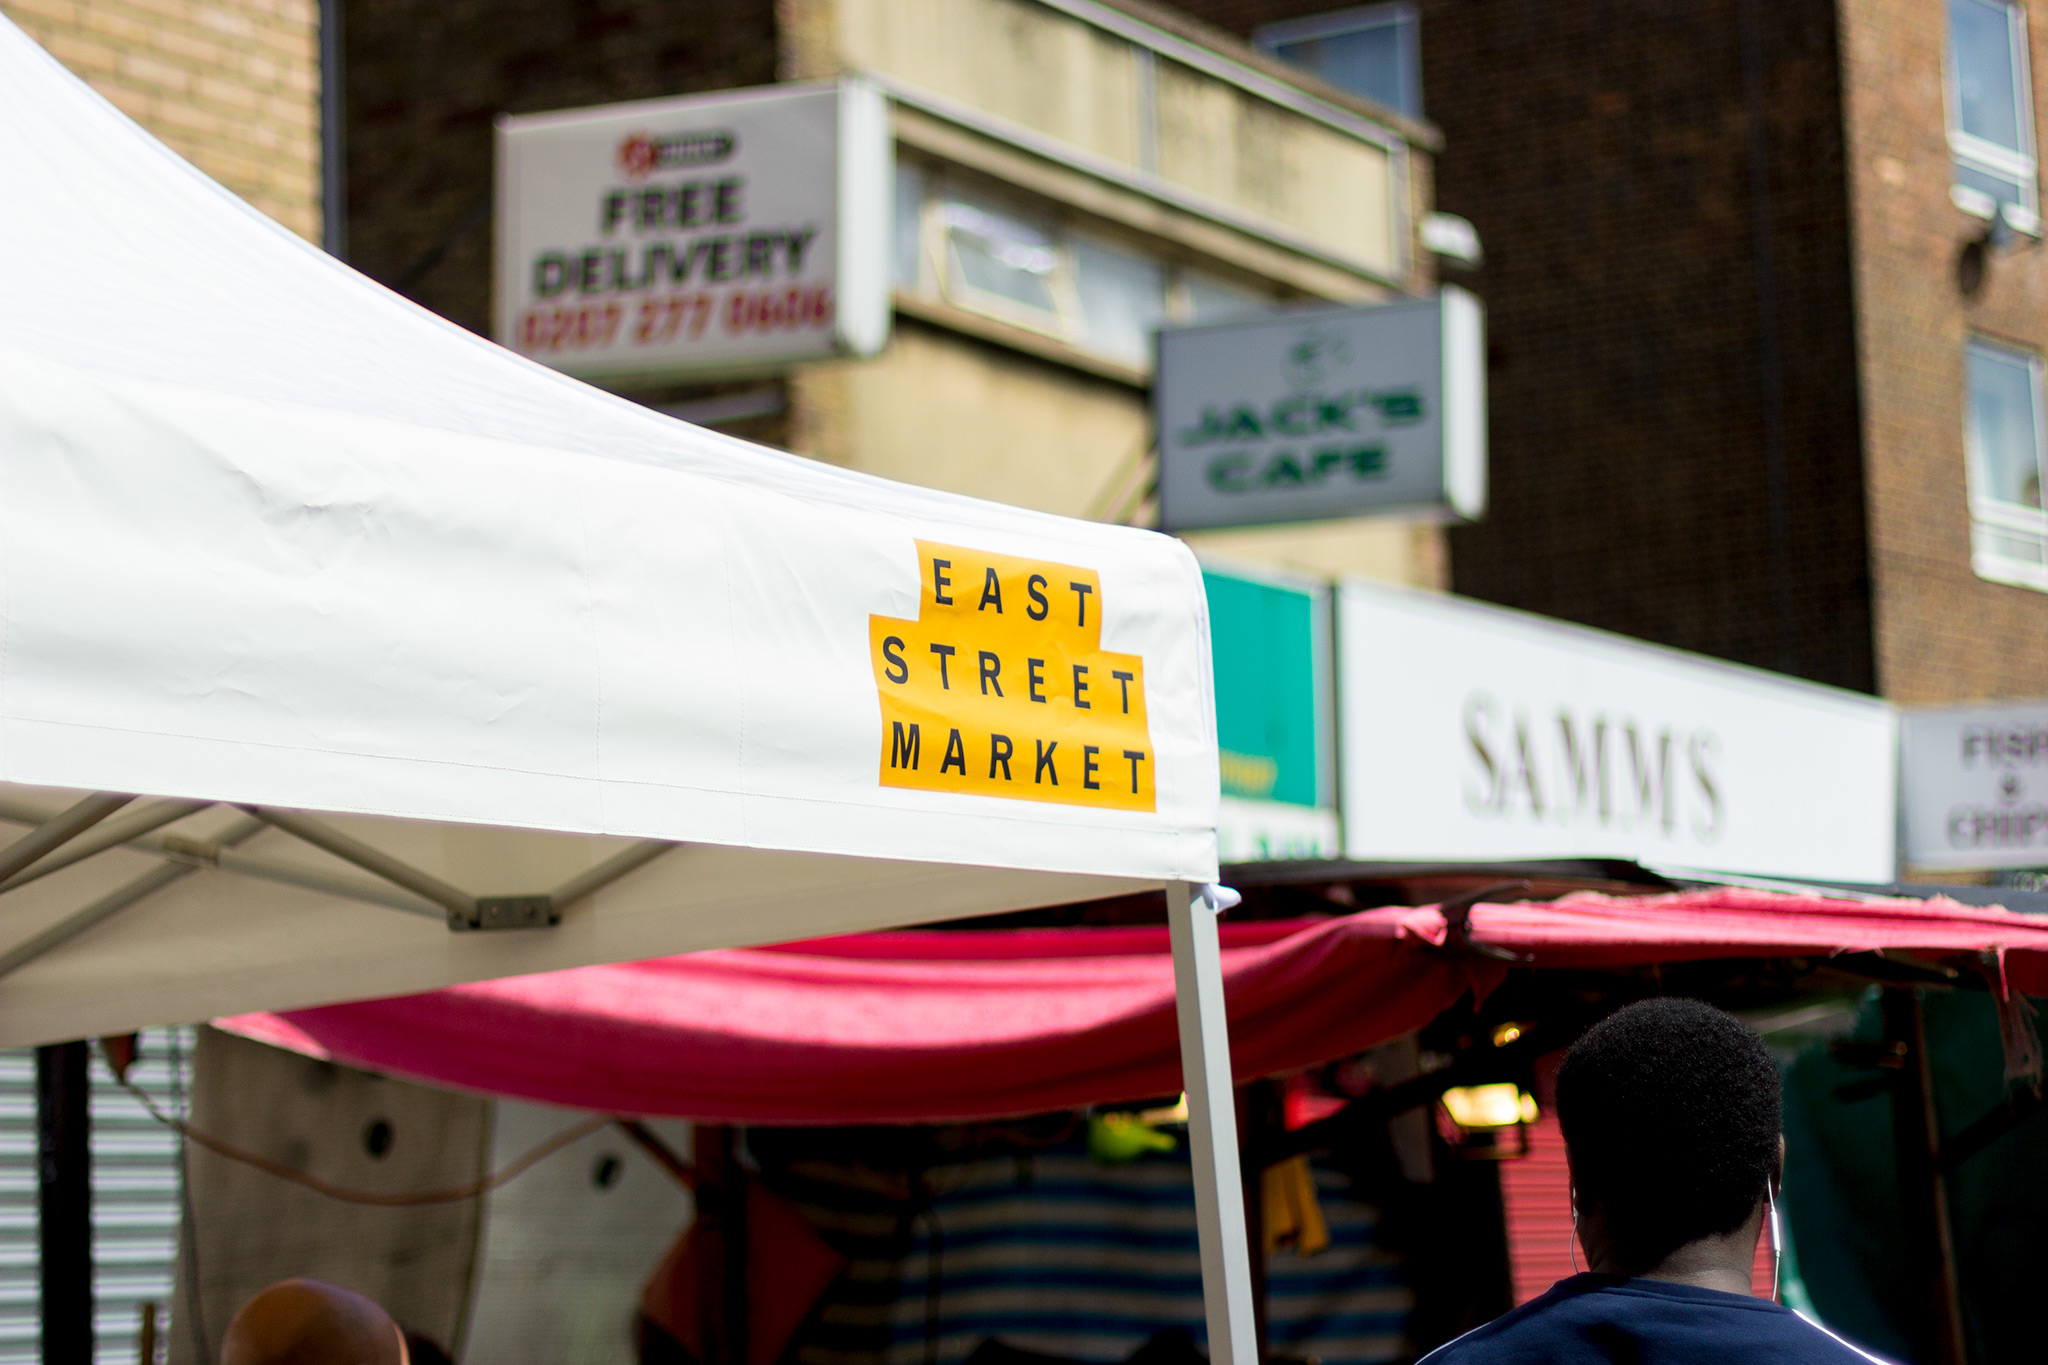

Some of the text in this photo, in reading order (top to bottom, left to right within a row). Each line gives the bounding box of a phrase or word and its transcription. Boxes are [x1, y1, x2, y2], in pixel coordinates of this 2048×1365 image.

[601, 177, 745, 236] FREE
[534, 224, 816, 298] DELIVERY
[517, 303, 622, 354] 0207
[634, 290, 714, 345] 277
[1178, 386, 1424, 446] JACK'S
[1207, 442, 1388, 493] CAFE
[932, 557, 1093, 628] EAST
[882, 635, 1134, 715] STREET
[890, 720, 1145, 795] MARKET
[1462, 691, 1726, 845] SAMMS
